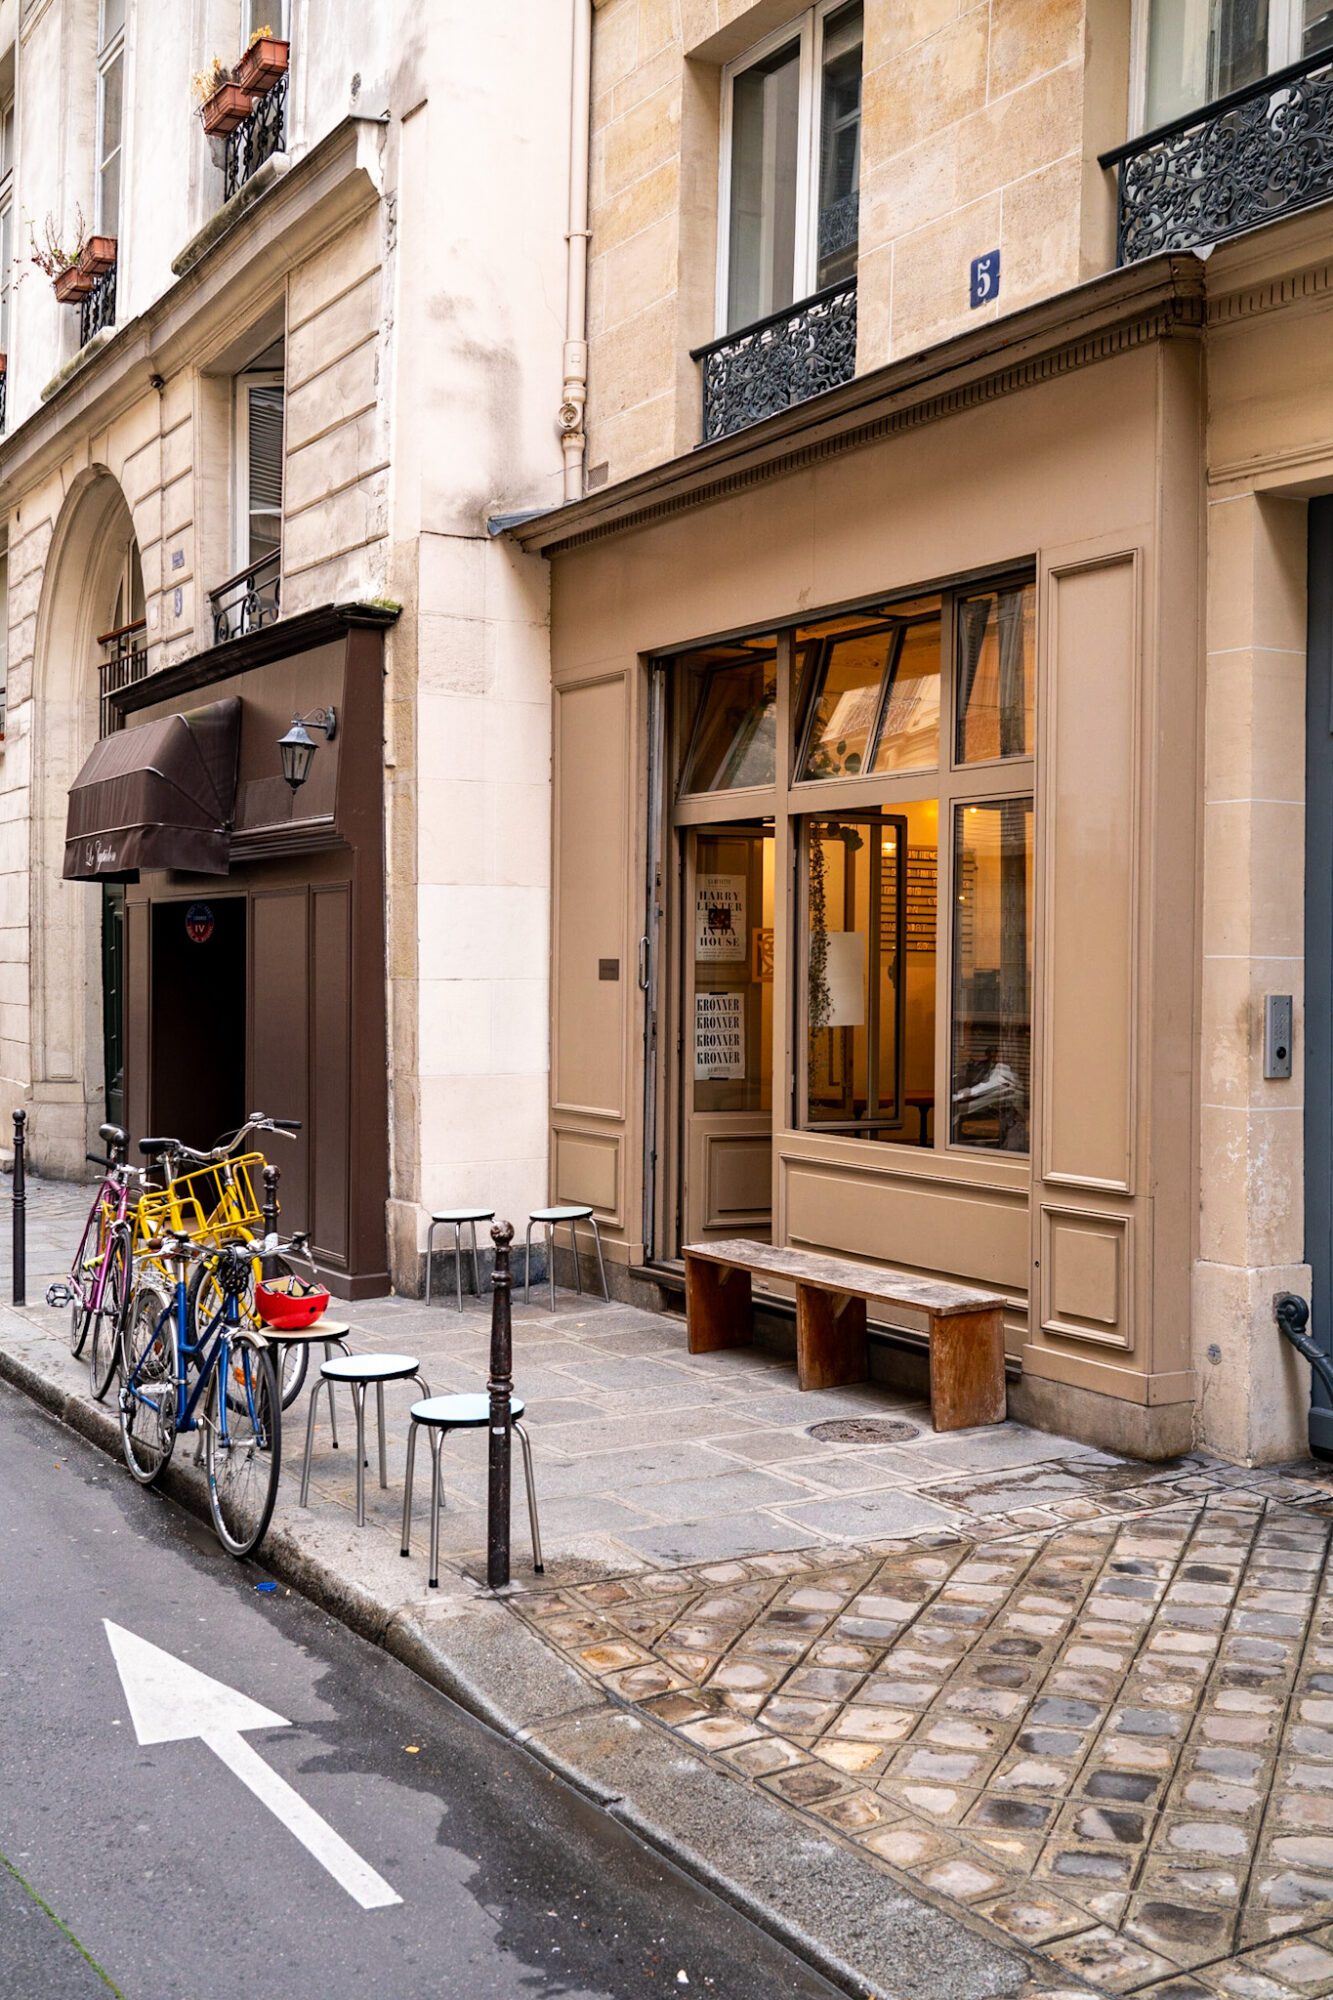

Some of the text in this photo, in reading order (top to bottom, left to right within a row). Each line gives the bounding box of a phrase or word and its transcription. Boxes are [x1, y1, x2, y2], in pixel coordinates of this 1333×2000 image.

[977, 259, 991, 297] 5
[699, 890, 739, 901] HARRY
[697, 901, 742, 912] LESTER
[700, 937, 740, 947] HOUSE
